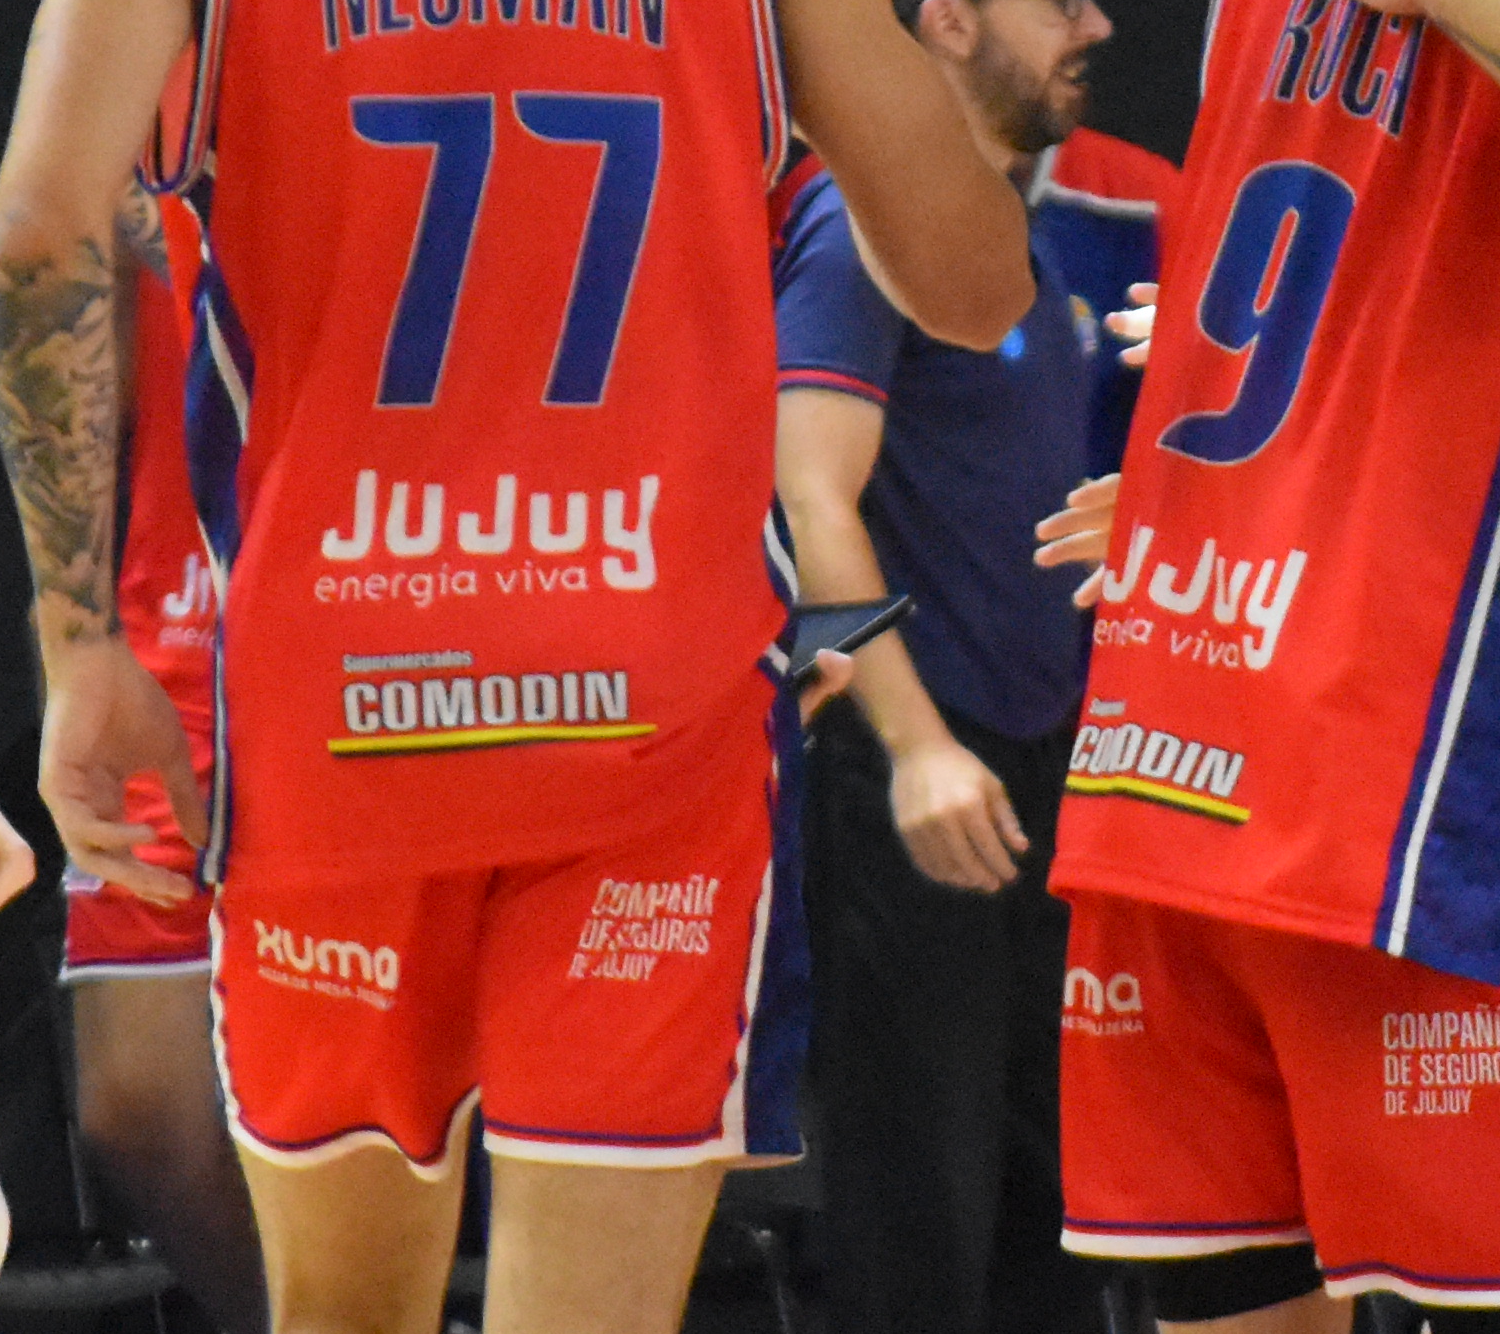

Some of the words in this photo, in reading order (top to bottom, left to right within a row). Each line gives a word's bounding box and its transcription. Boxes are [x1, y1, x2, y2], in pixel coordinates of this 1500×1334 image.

[349, 92, 664, 408] 77
[1156, 159, 1357, 465] 9
[496, 560, 588, 594] viva
[1170, 628, 1240, 667] viva
[342, 671, 630, 734] COMODIN
[1385, 1053, 1413, 1087] DE
[1384, 1090, 1407, 1116] DE
[1413, 1089, 1472, 1115] JUJUY
